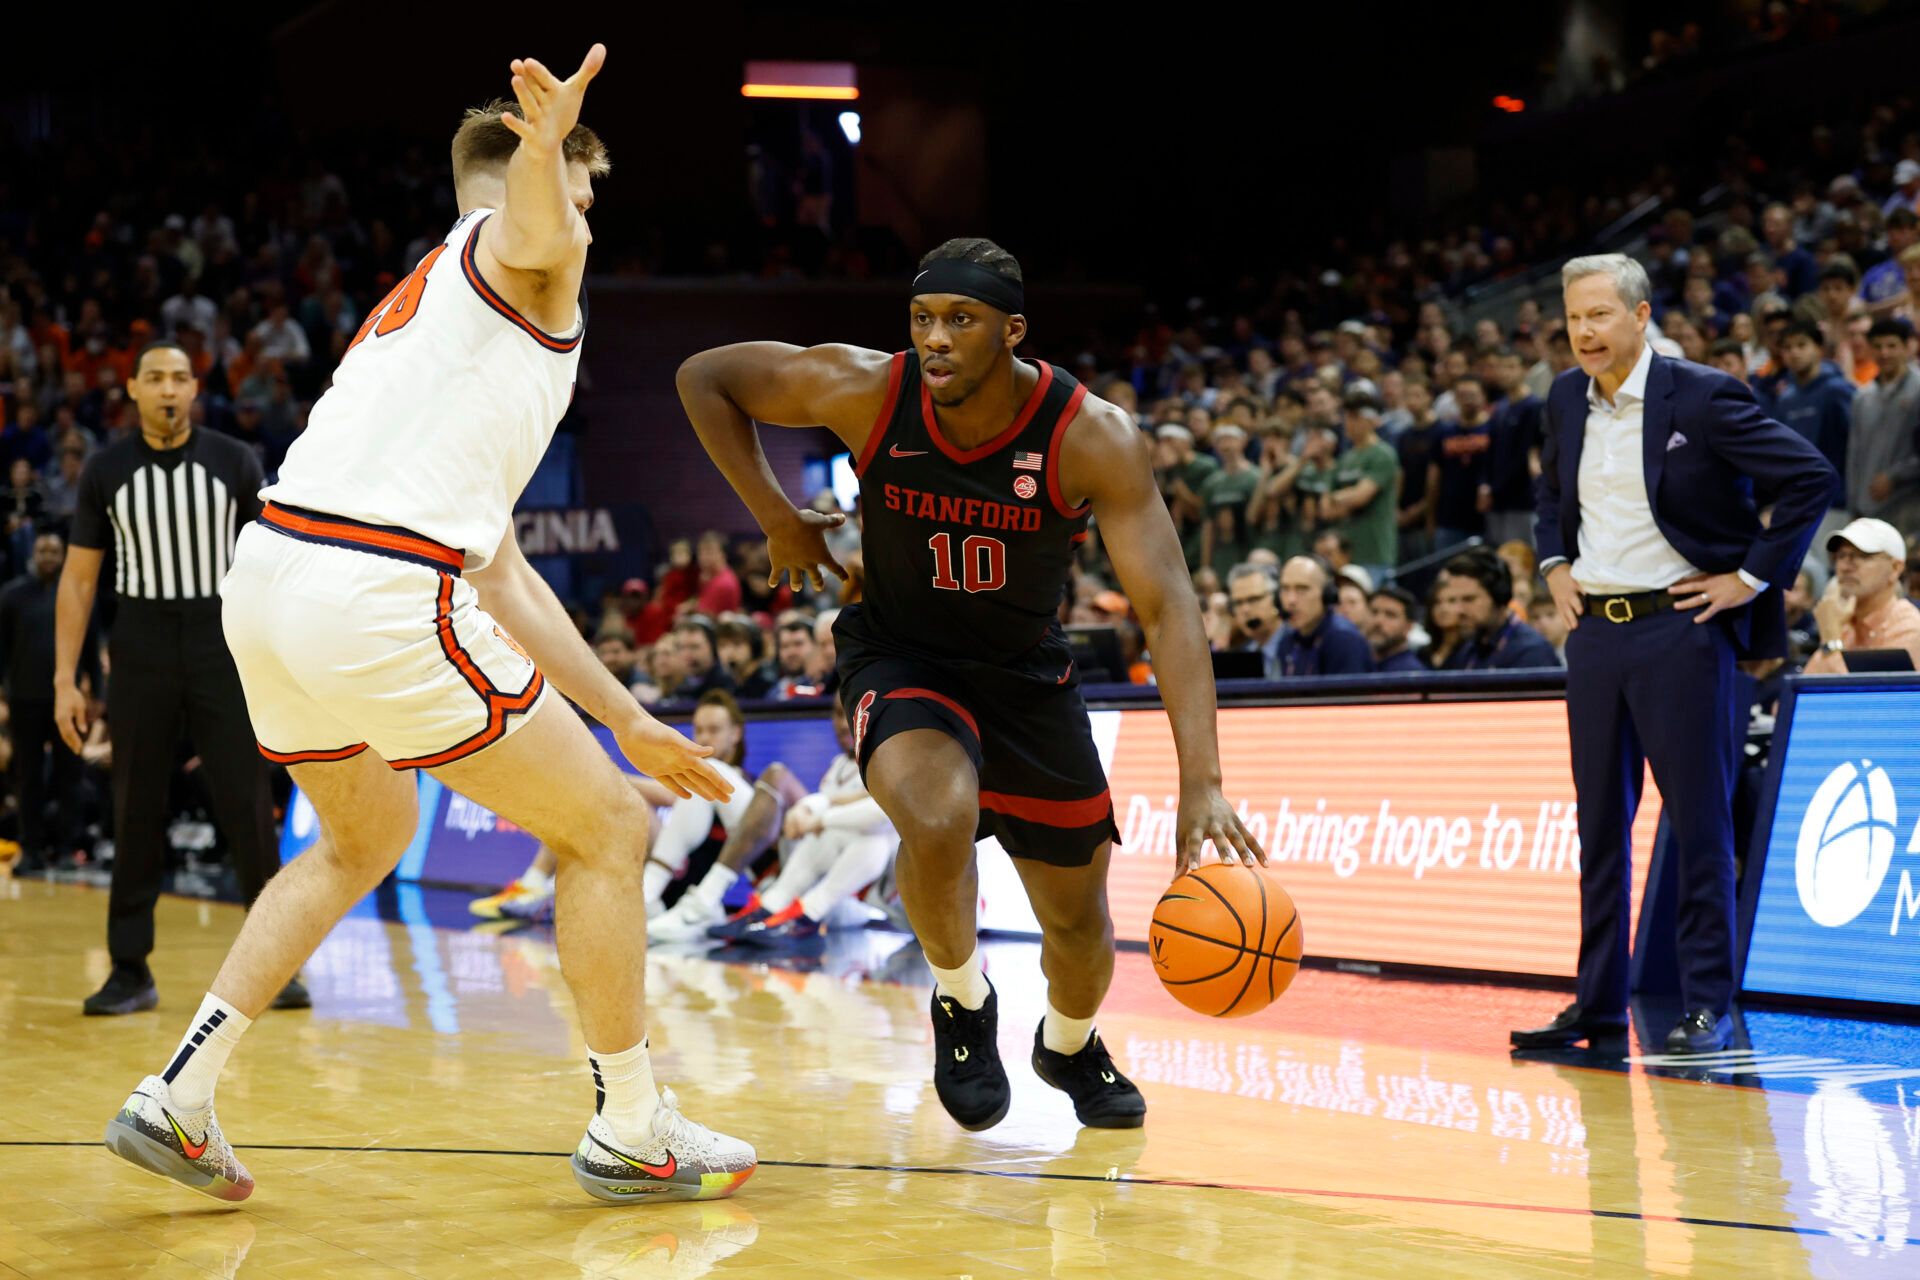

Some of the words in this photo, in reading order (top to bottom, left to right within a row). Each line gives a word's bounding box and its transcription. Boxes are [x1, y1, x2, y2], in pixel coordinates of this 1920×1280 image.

[884, 483, 1042, 532] STANFORD
[928, 532, 1006, 594] 10
[1270, 797, 1370, 878] bring
[1369, 798, 1472, 881] hope
[1479, 802, 1523, 872] to
